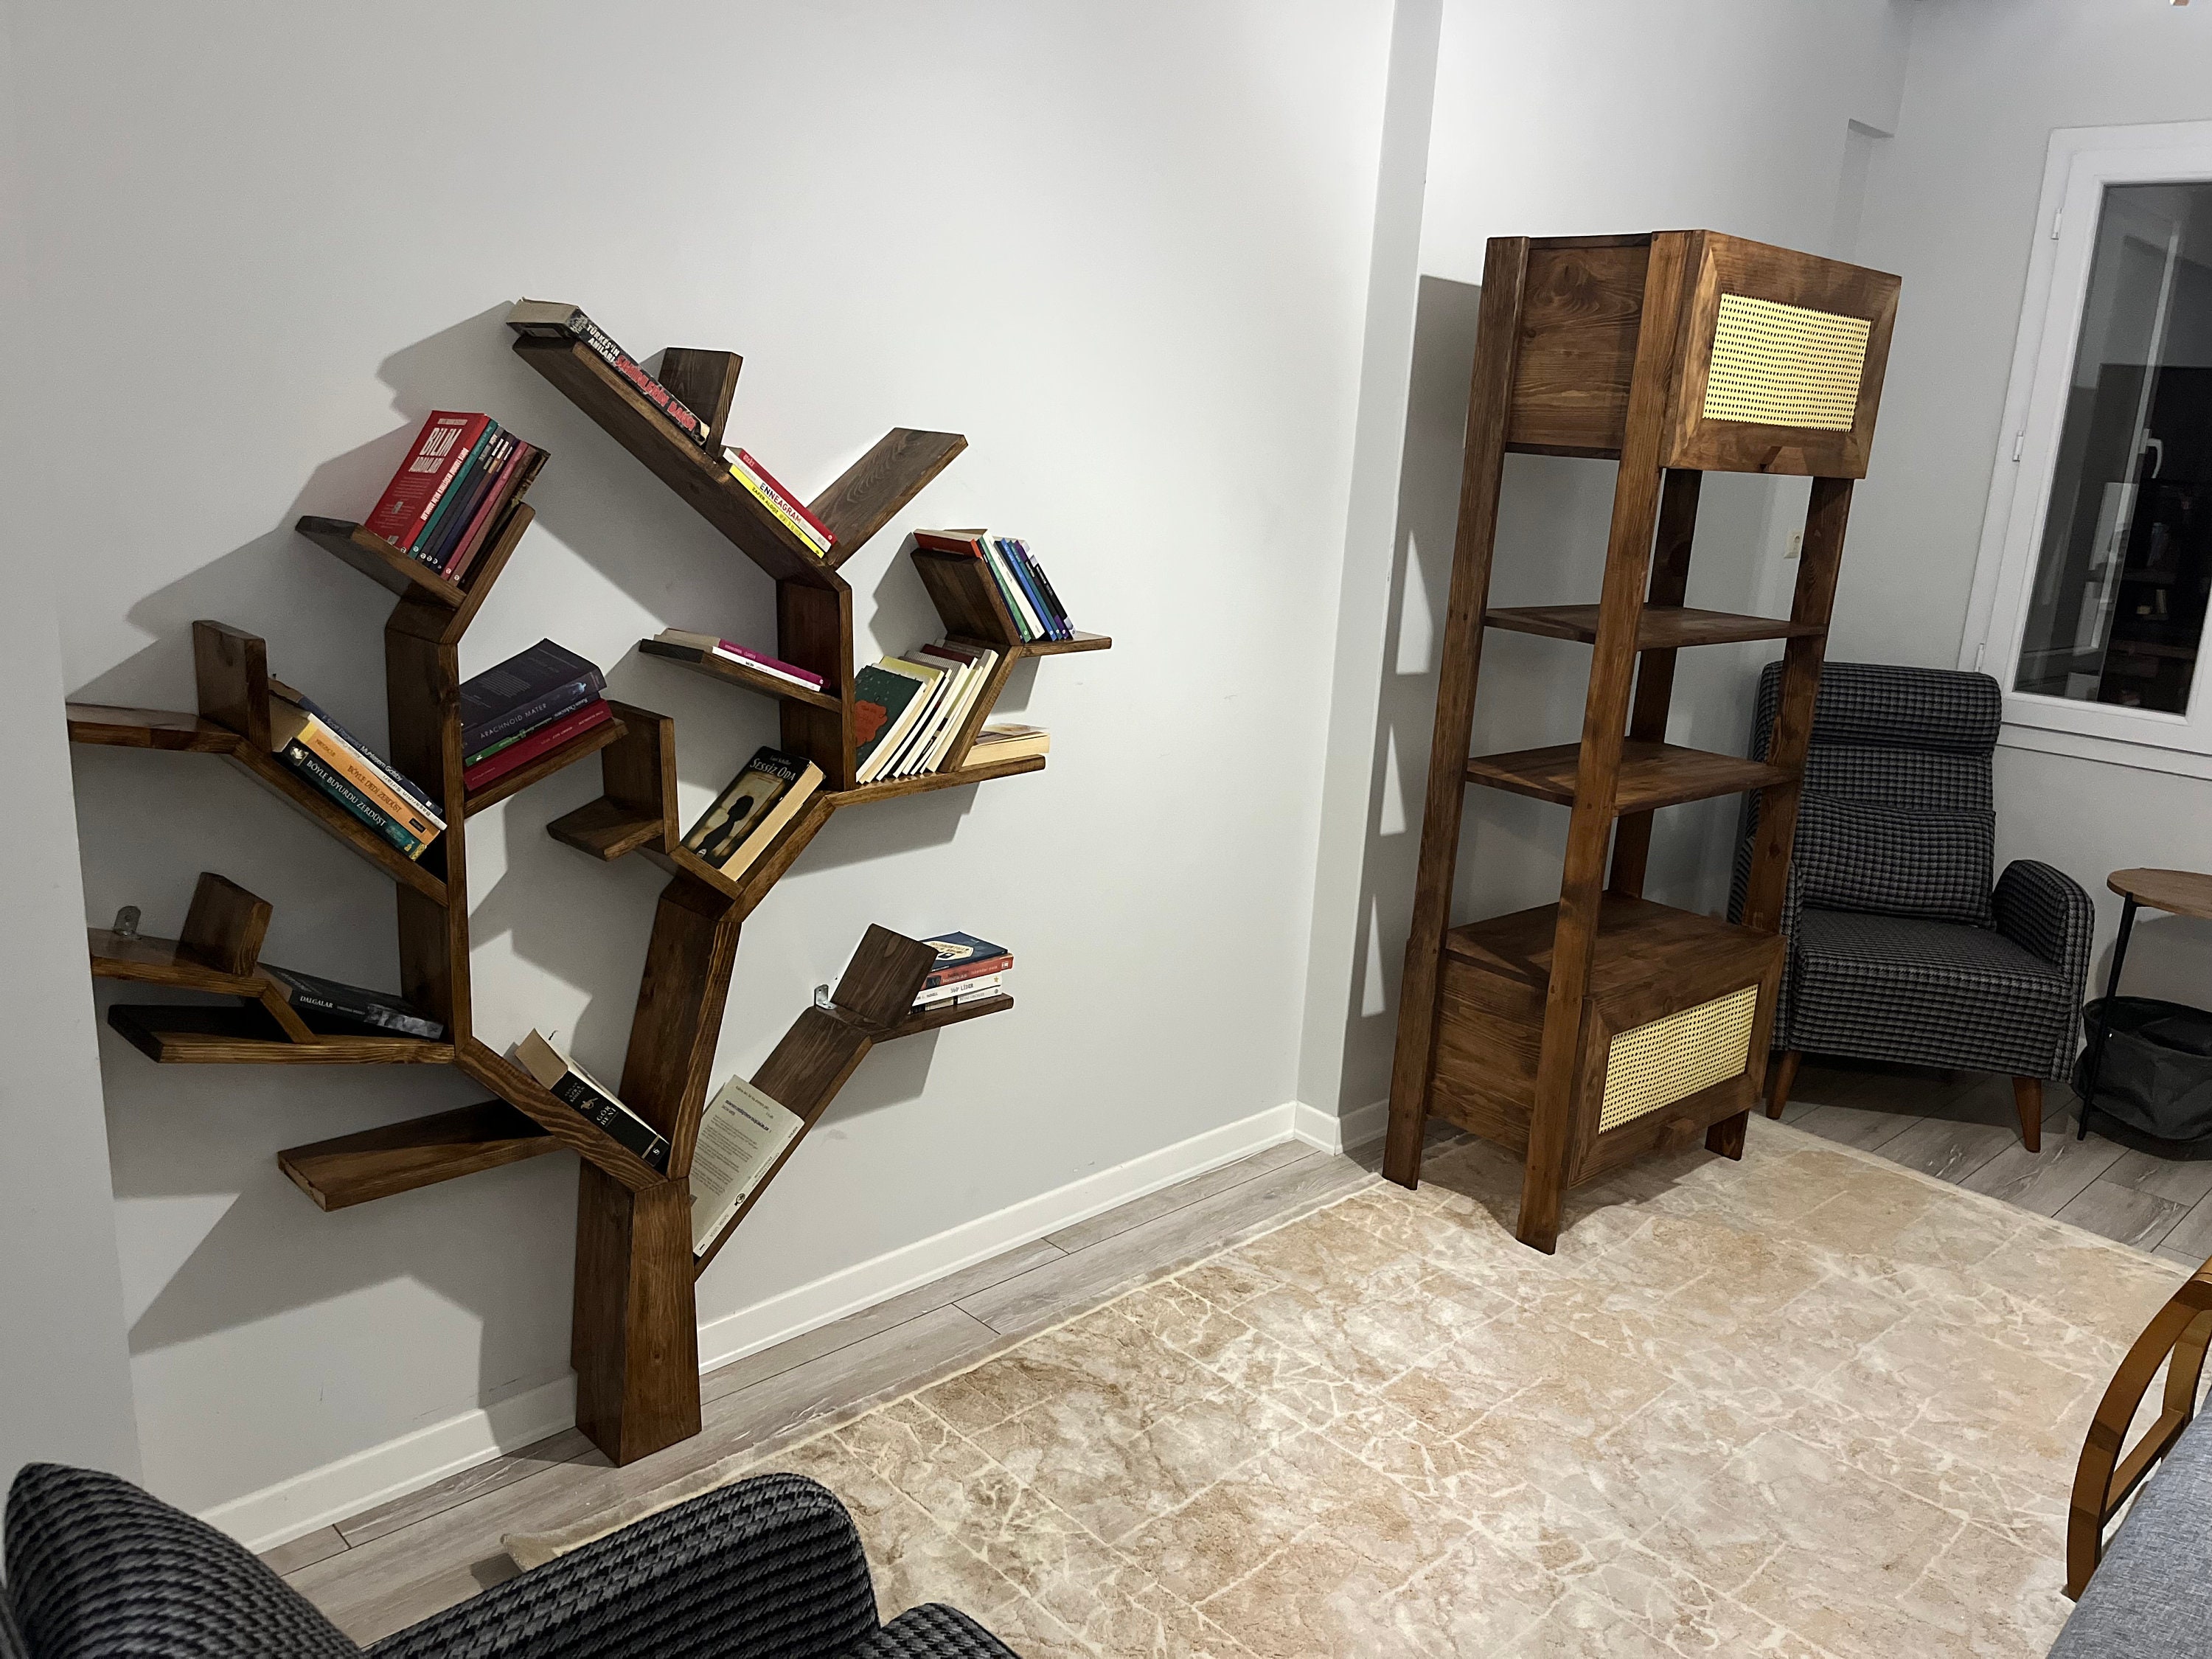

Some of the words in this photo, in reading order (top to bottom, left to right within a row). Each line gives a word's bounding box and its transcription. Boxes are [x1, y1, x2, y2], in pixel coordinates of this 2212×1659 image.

[587, 324, 620, 357] TÜRKEŞ'İN
[588, 338, 616, 363] ANILARI
[667, 400, 697, 431] DANSI
[419, 428, 462, 456] BİLİM
[751, 486, 765, 501] ZAFER
[759, 482, 802, 524] ENNEAGRAM
[480, 714, 524, 739] ARACHNOID
[524, 703, 548, 717] MATER
[360, 745, 387, 768] Muhteşem
[385, 765, 403, 782] Gatsby
[749, 758, 776, 774] SESSİZ
[776, 766, 796, 782] ODA
[306, 759, 328, 780] BÖYLE
[327, 776, 358, 804] BUYURDU
[356, 798, 387, 827] ZERDÜŞT
[347, 764, 366, 784] BÖYLE
[364, 779, 380, 796] DEDİ
[377, 790, 403, 814] ZERDÜŞT
[300, 995, 333, 1009] DALGALAR
[597, 1105, 611, 1121] GÖR
